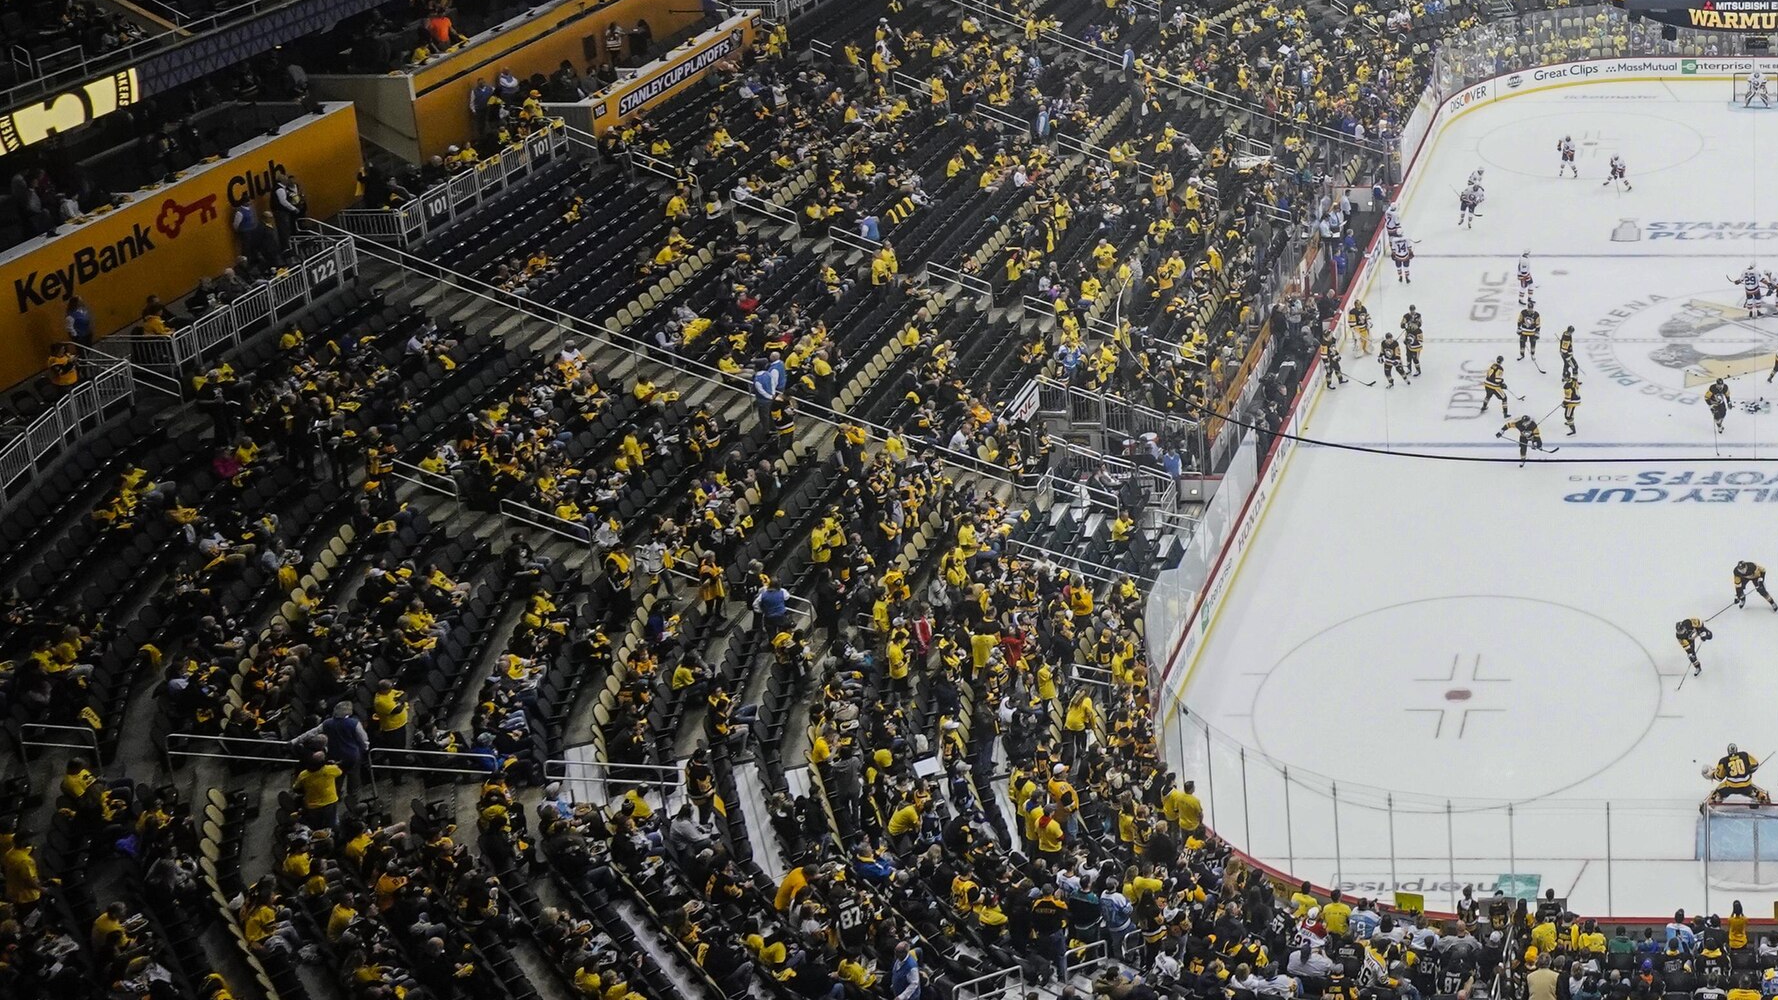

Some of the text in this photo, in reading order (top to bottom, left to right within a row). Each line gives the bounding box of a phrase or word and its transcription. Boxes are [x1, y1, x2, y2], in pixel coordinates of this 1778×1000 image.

[1715, 1, 1769, 11] MITSUBISHI
[1534, 64, 1599, 81] Great Clips
[1617, 62, 1678, 72] MassMutual
[1684, 60, 1752, 73] enterprise
[620, 39, 731, 114] STANLEY CUP PLAYOFFS
[1450, 85, 1487, 114] DISCOVER
[532, 137, 550, 158] 101
[429, 200, 449, 217] 101
[14, 222, 156, 315] KeyBank
[311, 259, 336, 285] 122
[1744, 275, 1756, 286] 29
[1469, 271, 1509, 322] GNC
[1590, 294, 1669, 337] ARENA
[1563, 488, 1671, 503] CUP
[1238, 492, 1266, 552] HONDA
[1726, 758, 1745, 776] 30
[839, 908, 863, 929] 87
[1444, 978, 1460, 994] 87
